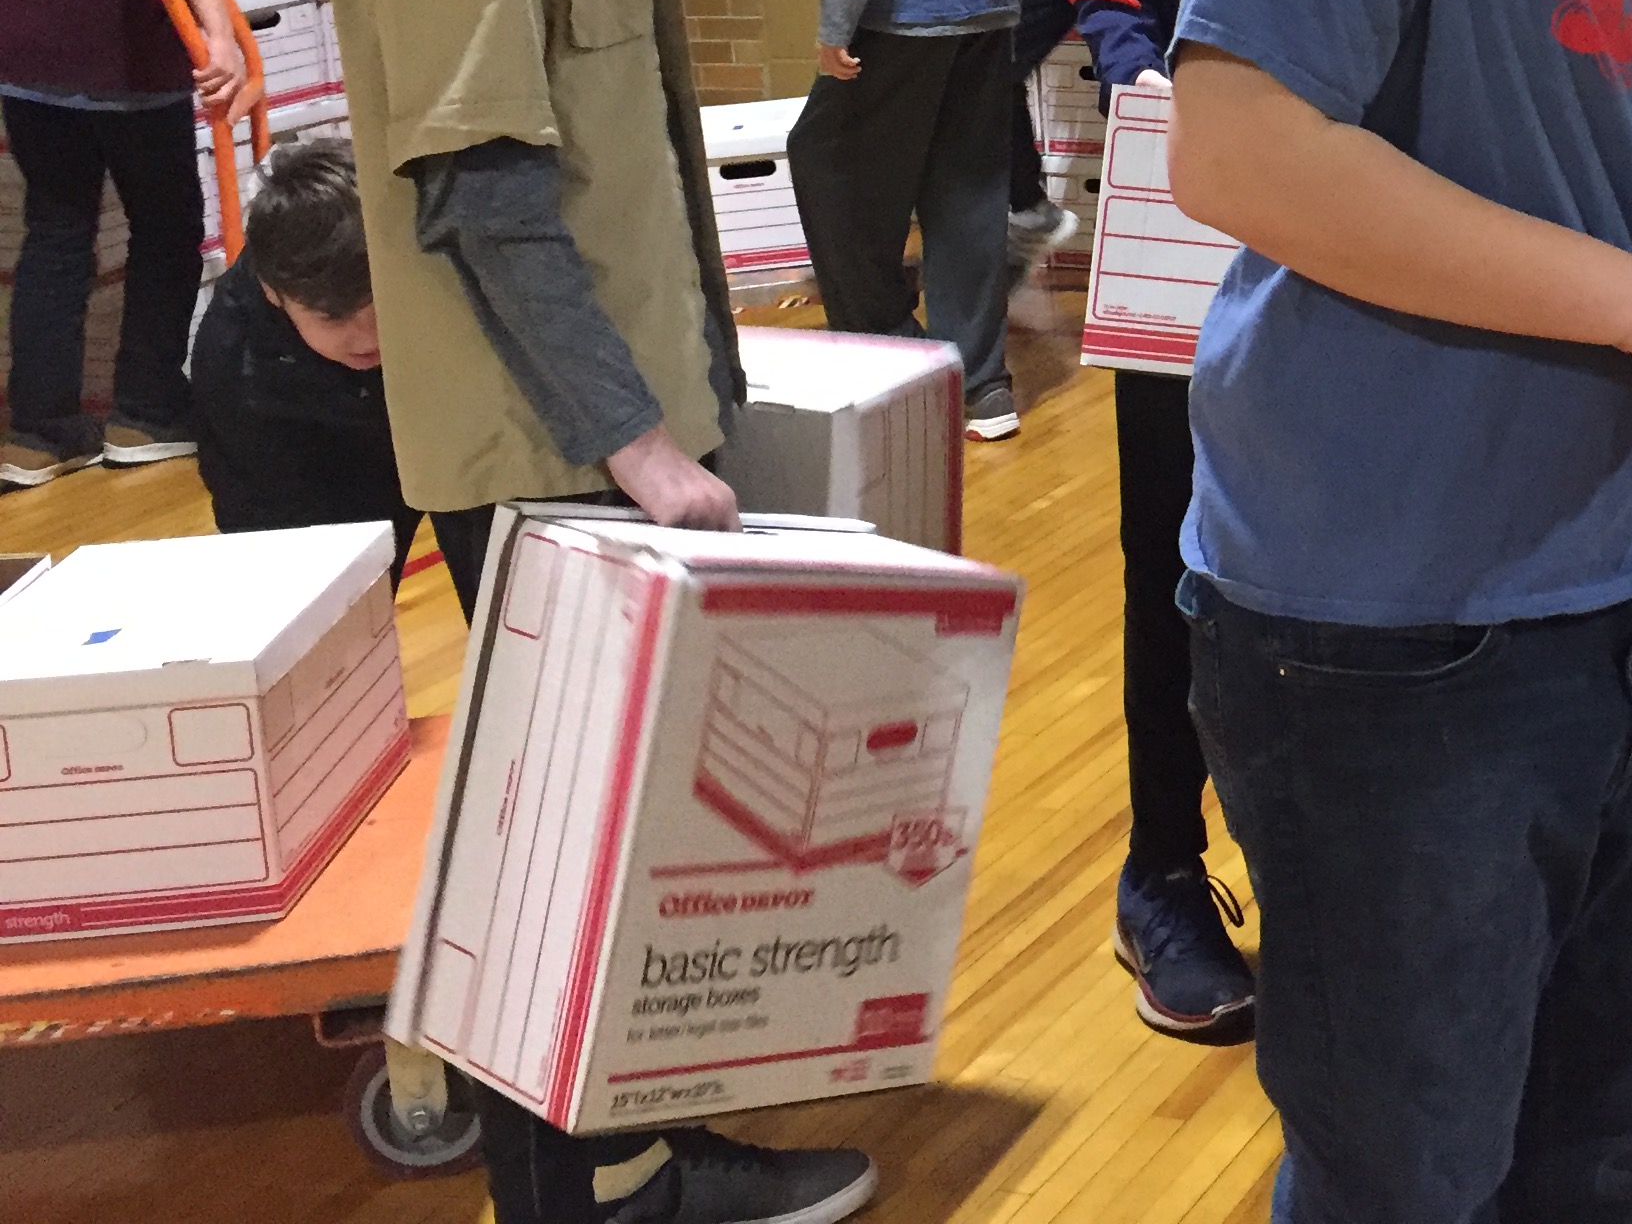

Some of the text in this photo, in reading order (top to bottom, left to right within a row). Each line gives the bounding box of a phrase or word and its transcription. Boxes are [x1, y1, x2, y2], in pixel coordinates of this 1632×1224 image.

[5, 910, 71, 930] strength
[640, 923, 902, 988] basic strength
